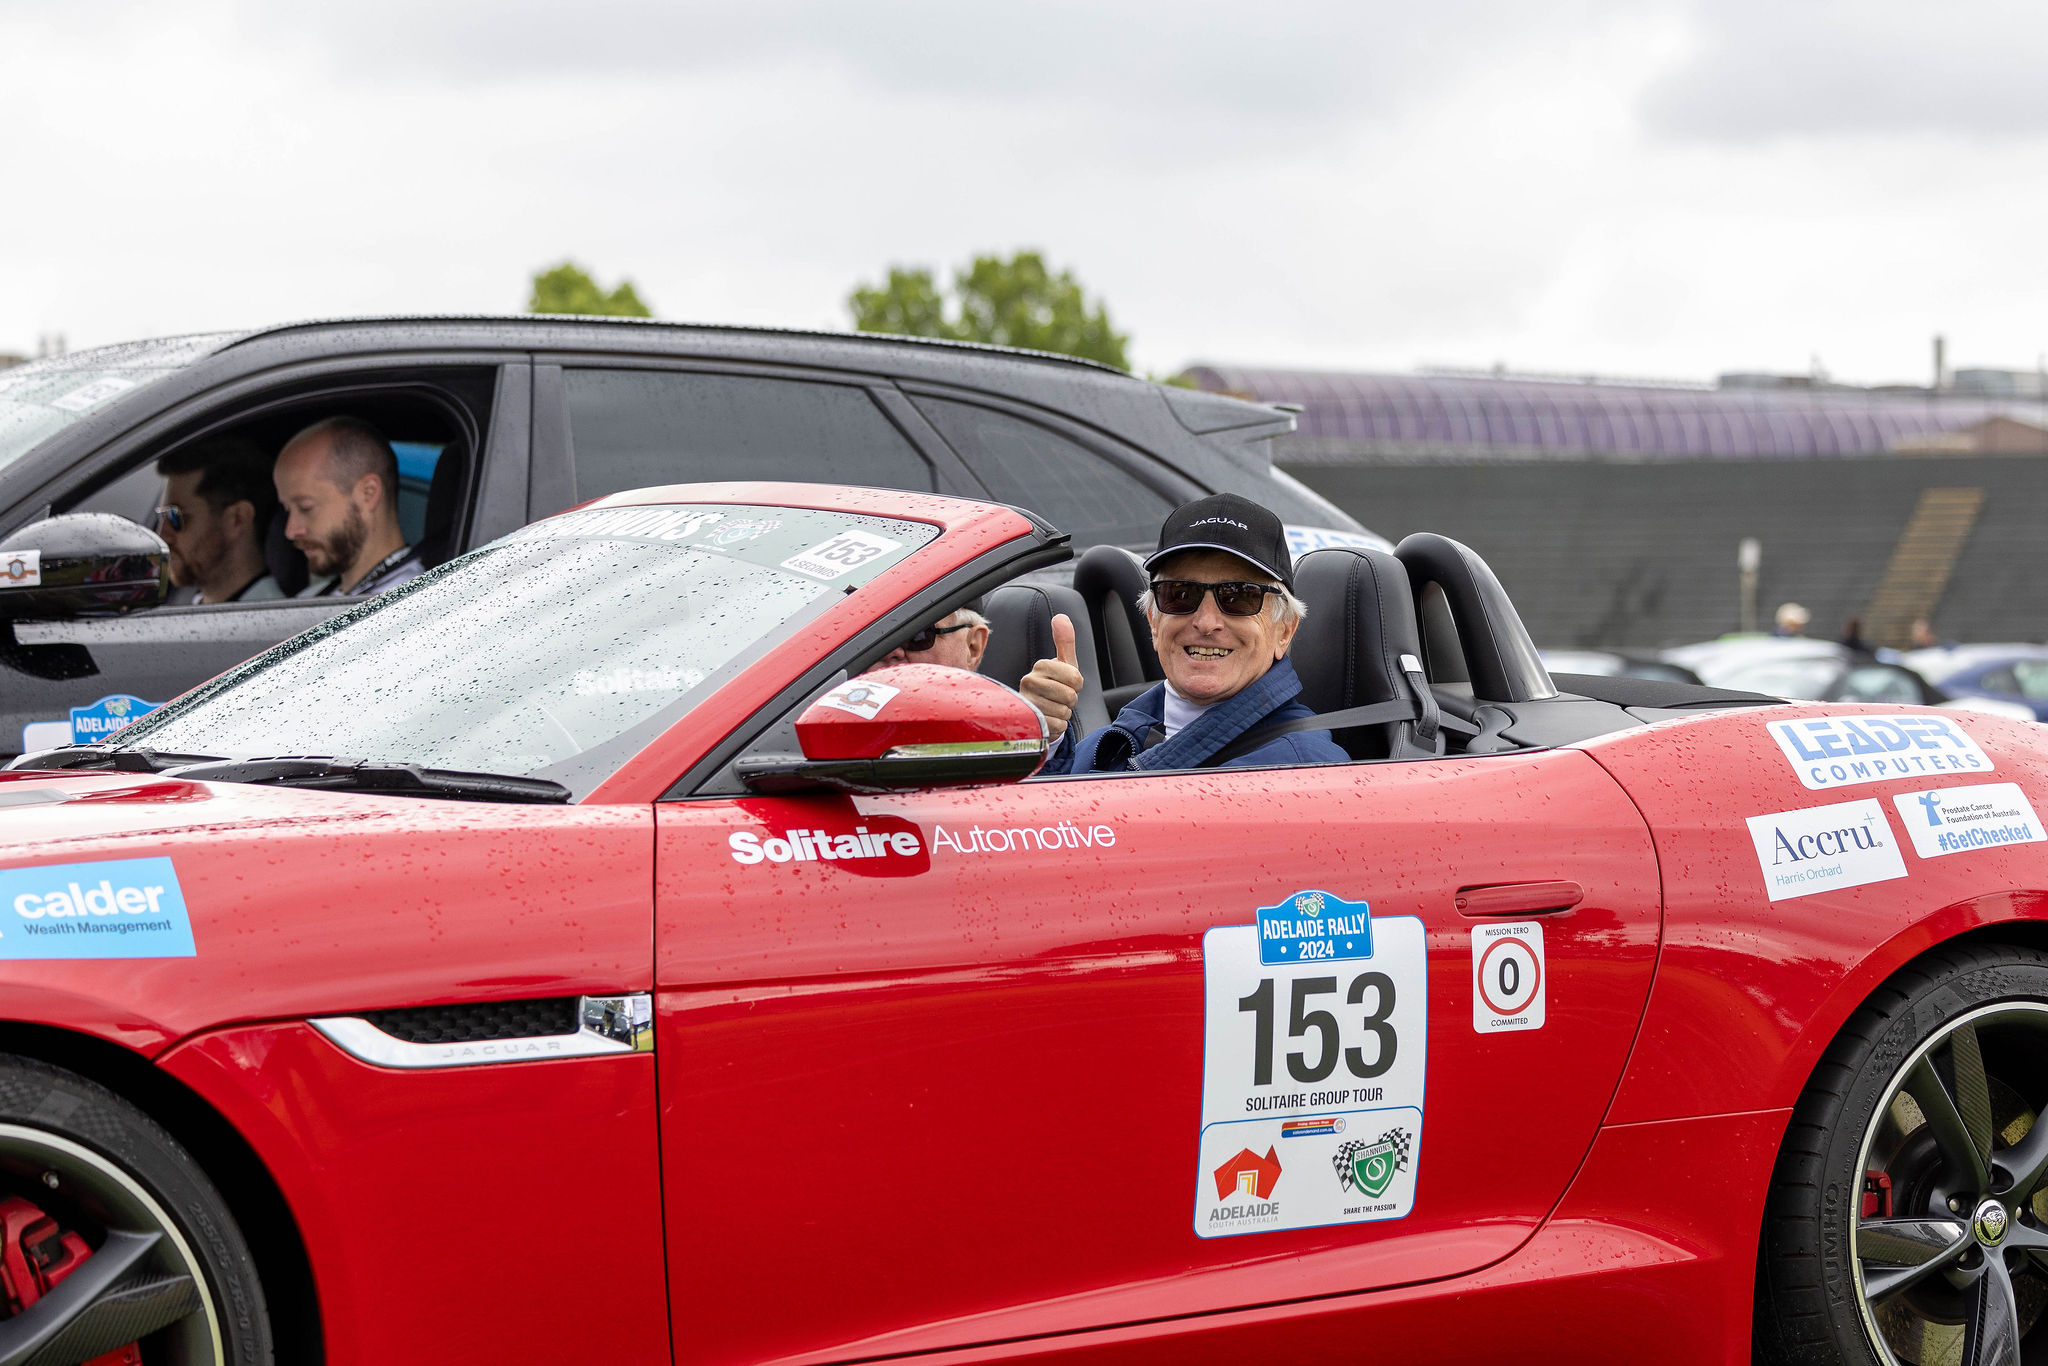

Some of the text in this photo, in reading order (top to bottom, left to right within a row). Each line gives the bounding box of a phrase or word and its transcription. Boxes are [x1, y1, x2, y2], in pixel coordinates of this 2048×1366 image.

[1188, 517, 1249, 531] JAGUAR
[814, 538, 882, 566] 153
[1780, 718, 1967, 762] LEADER
[1811, 753, 1981, 784] COMPUTERS
[1941, 803, 1993, 815] Prostate Cancer
[1946, 808, 2021, 824] Foundation of Australia
[728, 819, 1116, 865] Solitaire Automotive
[1938, 823, 2033, 851] #GetChecked
[1776, 863, 1843, 887] Harris Orchard
[14, 880, 165, 919] calder
[24, 919, 173, 935] Wealth Management
[1263, 912, 1366, 940] ADELAIDE RALLY
[1485, 926, 1529, 937] MISSION ZERO
[1298, 939, 1335, 960] 2024
[1498, 957, 1519, 995] 0
[1238, 971, 1398, 1087] 153
[1490, 1017, 1528, 1027] COMMITTED
[442, 1041, 562, 1058] JAGUAR
[1246, 1087, 1384, 1112] SOLITAIRE GROUP TOUR
[1356, 1143, 1392, 1160] SHANNONS
[1209, 1202, 1280, 1221] ADELAIDE
[1343, 1203, 1397, 1215] SHARE THE PASSION
[1208, 1215, 1279, 1229] SOUTH AUSTRALIA
[1823, 1184, 1844, 1306] KUMHO
